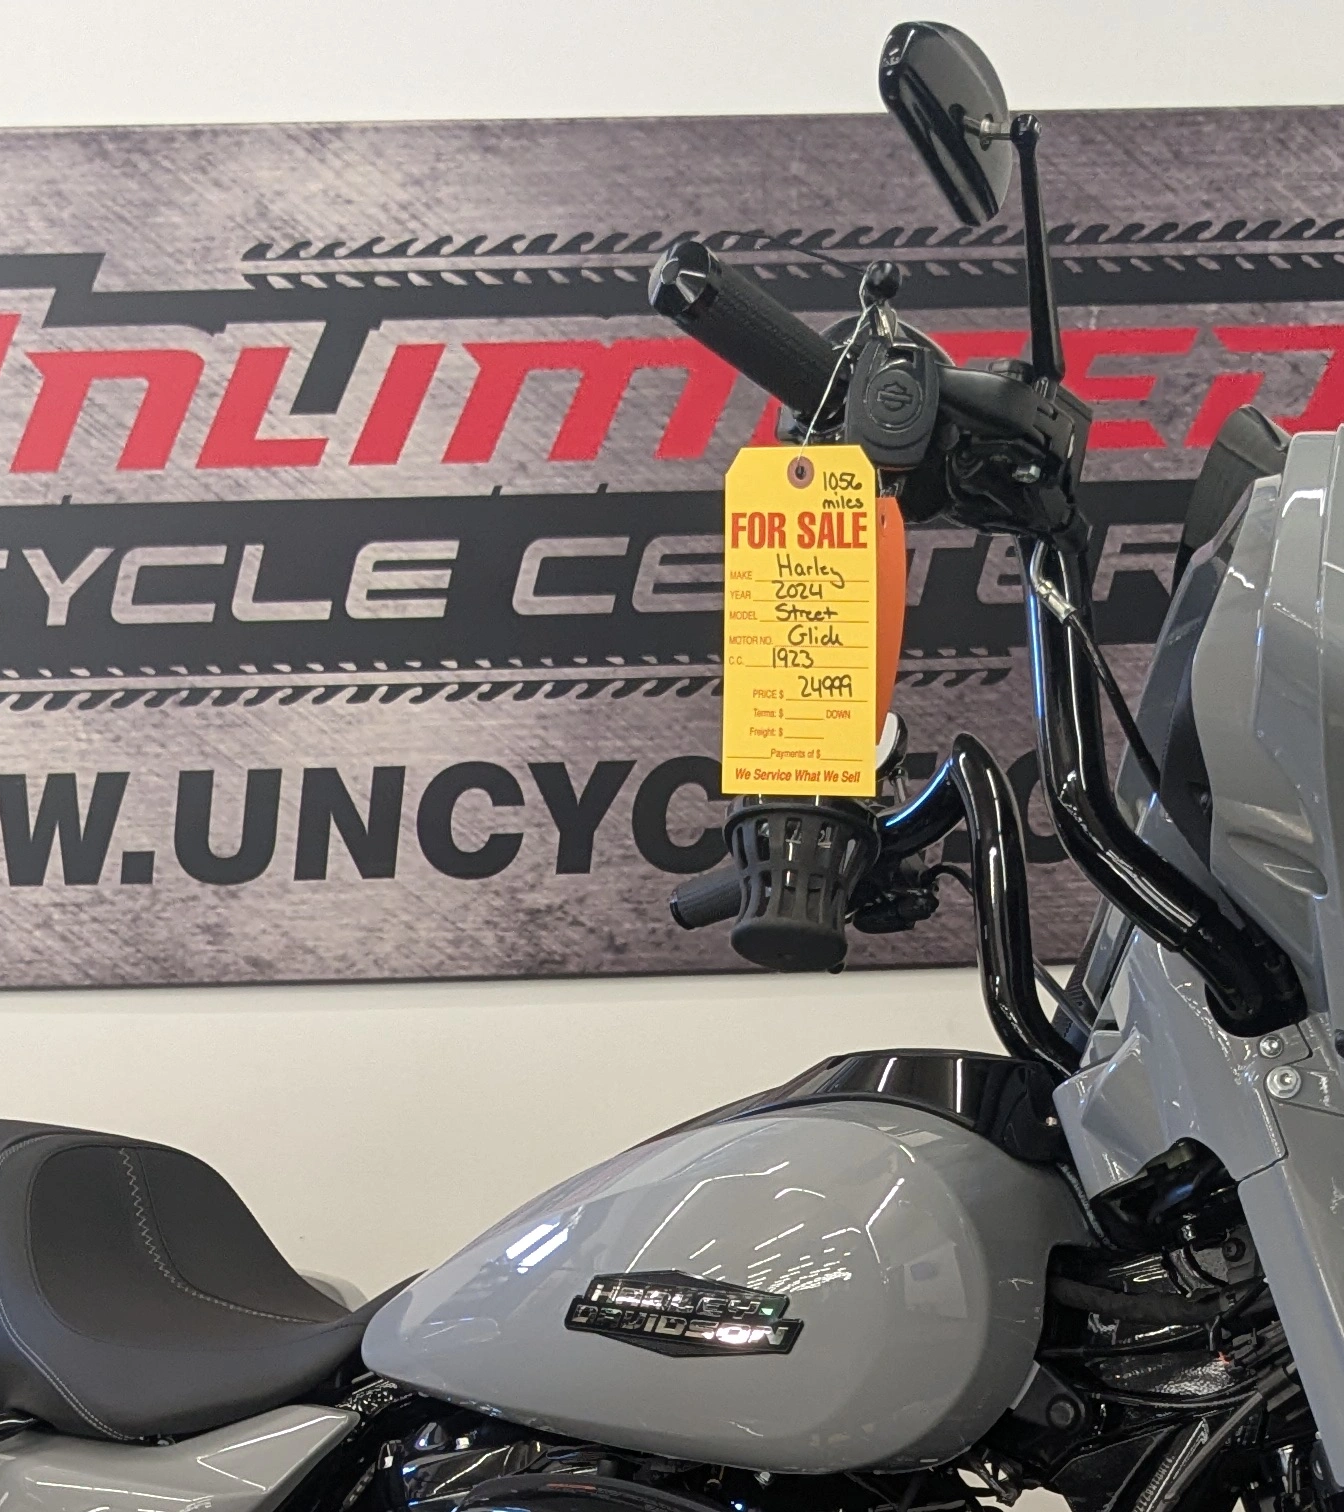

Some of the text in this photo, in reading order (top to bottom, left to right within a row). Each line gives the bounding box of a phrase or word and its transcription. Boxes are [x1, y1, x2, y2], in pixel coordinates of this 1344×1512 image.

[822, 471, 863, 491] 1056
[822, 491, 864, 509] miles
[731, 511, 868, 549] FOR SALE
[730, 553, 845, 589] MAKE Harley
[730, 580, 823, 599] YEAR 2024
[729, 603, 838, 621] MODEL Street
[728, 636, 758, 645] MOTOR
[759, 637, 773, 645] NO.
[772, 647, 814, 669] 1923
[752, 689, 777, 699] PRICE
[797, 674, 853, 698] 24999
[825, 709, 851, 719] DOWN
[770, 748, 806, 760] Payments
[735, 768, 861, 783] We Service What We Sell
[571, 1304, 789, 1346] DAVIDSON
